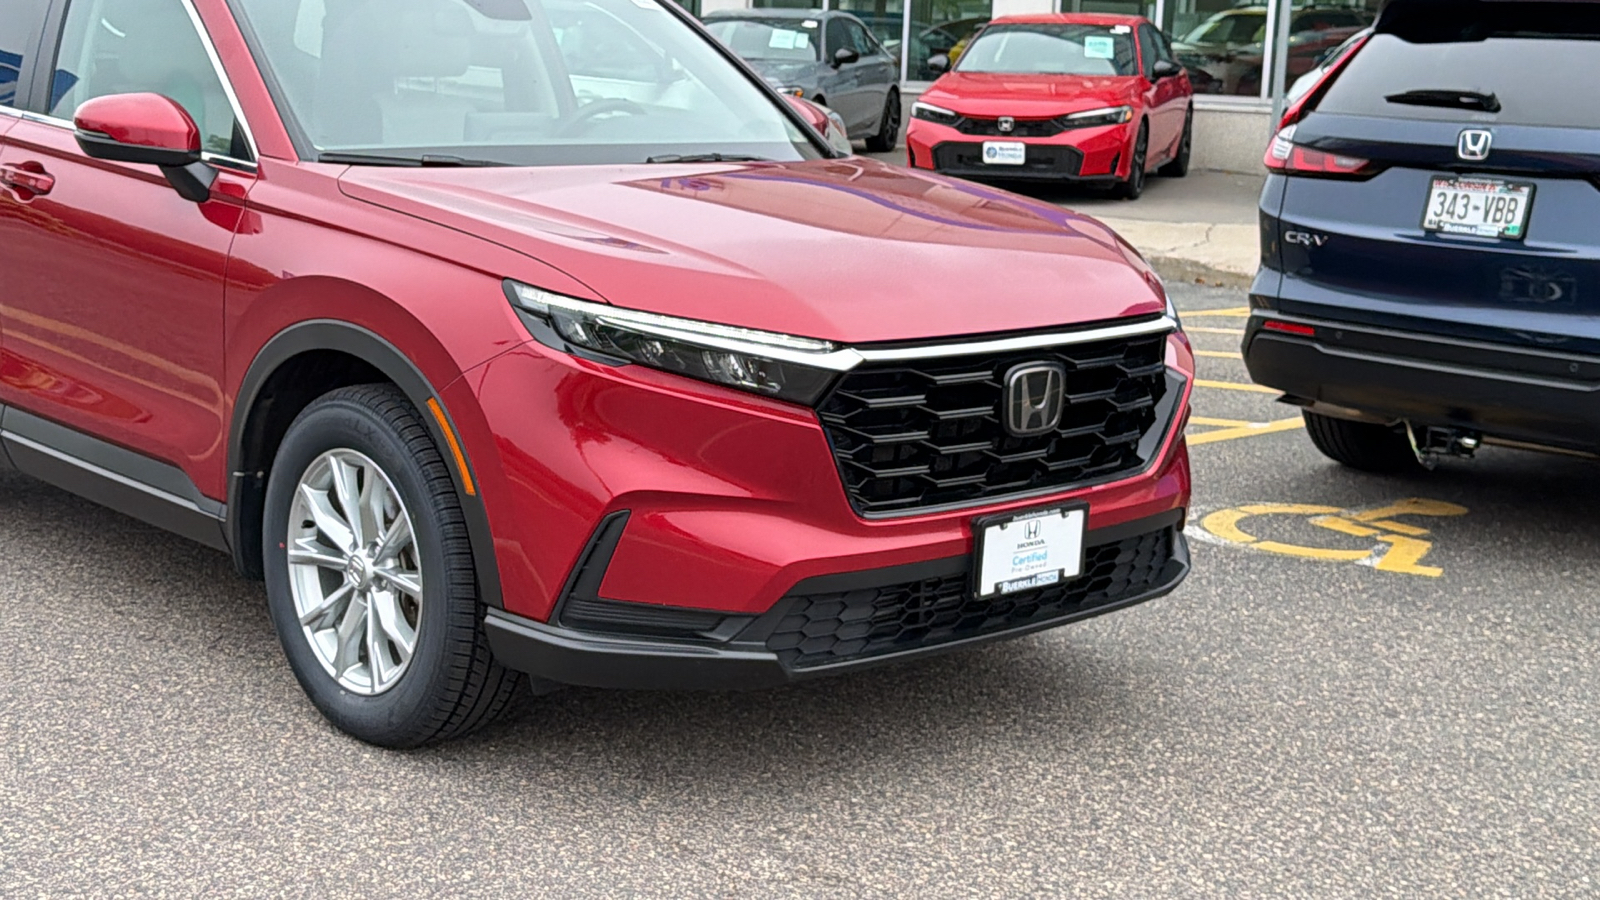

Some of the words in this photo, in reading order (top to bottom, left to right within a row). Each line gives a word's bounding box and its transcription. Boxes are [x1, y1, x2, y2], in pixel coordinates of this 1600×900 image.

[1433, 192, 1519, 224] 343-VBB
[1284, 230, 1329, 247] CR-V
[1017, 539, 1045, 549] HONDA
[1012, 551, 1047, 566] Certified
[1002, 577, 1035, 593] BUERKLE
